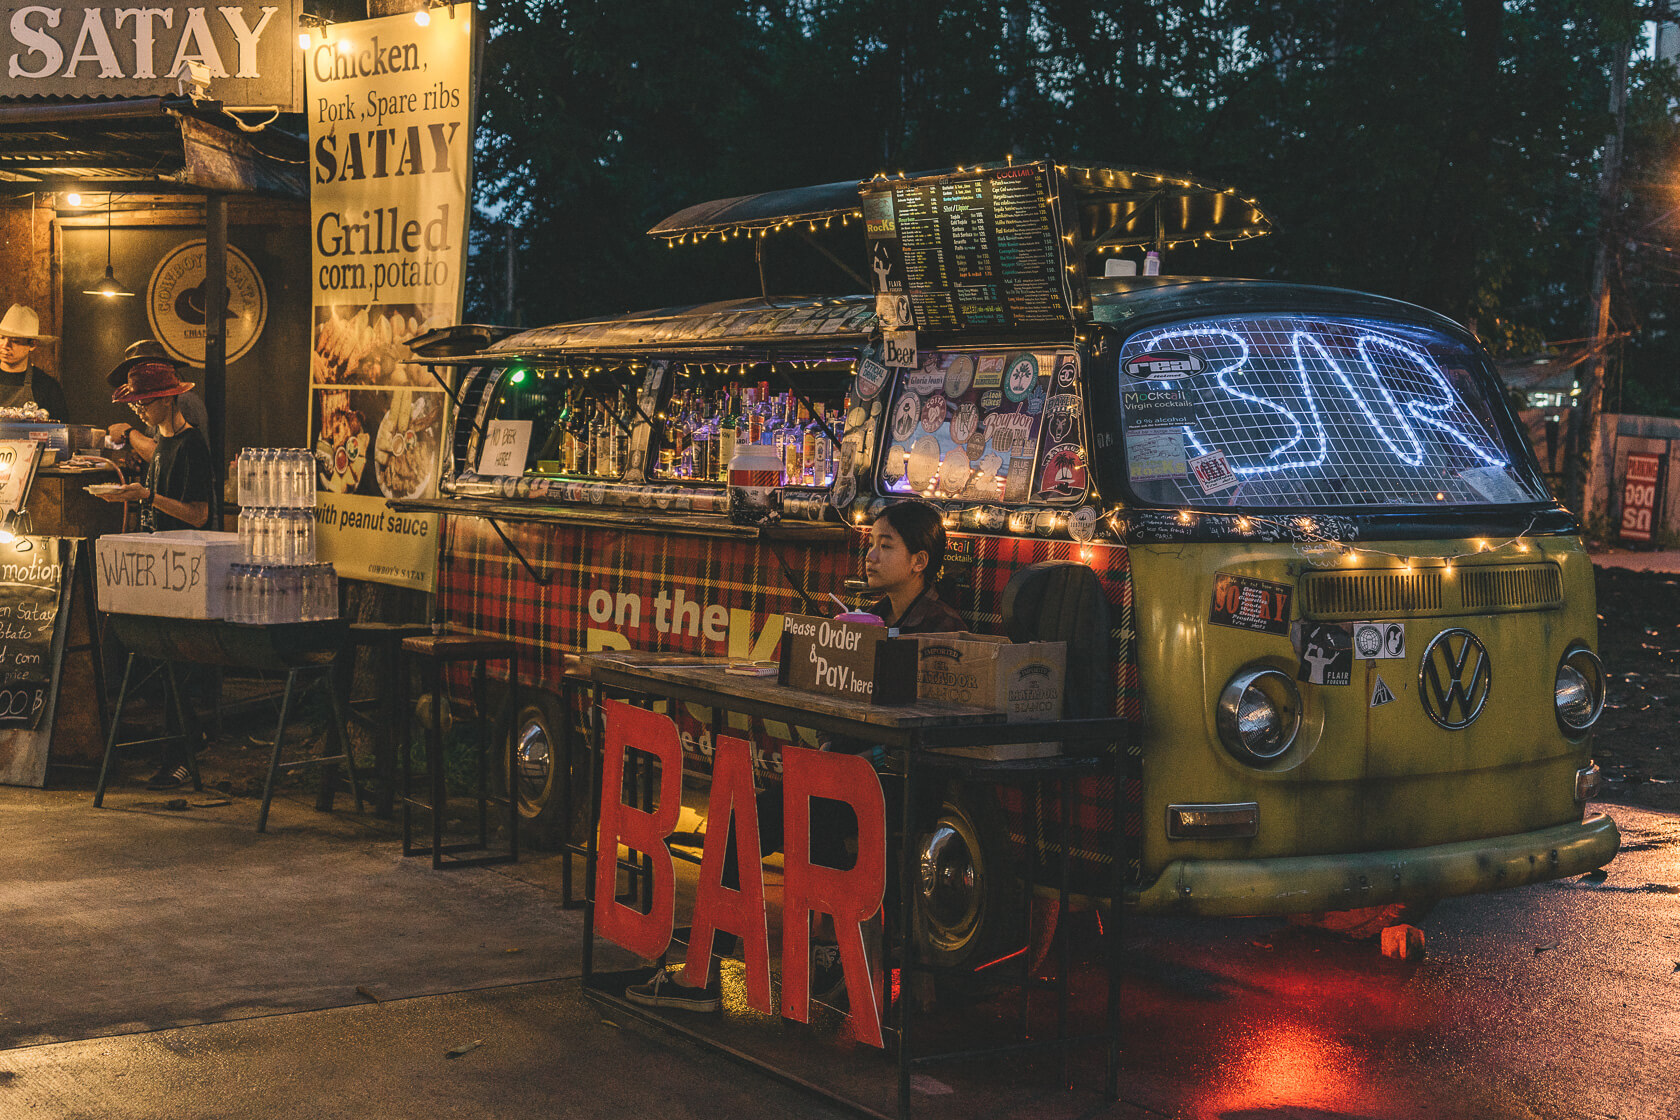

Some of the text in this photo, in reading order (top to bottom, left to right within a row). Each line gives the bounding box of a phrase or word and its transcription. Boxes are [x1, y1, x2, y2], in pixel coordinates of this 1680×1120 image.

[8, 5, 279, 80] SATAY
[313, 36, 428, 84] Chicken,
[317, 97, 356, 124] Pork
[423, 82, 460, 110] ribs
[315, 122, 460, 186] SATAY
[996, 169, 1034, 179] COCKTAILS
[316, 203, 452, 258] Grilled
[887, 340, 916, 365] Beer
[1128, 355, 1201, 374] real
[926, 395, 944, 409] COSTA
[1124, 400, 1193, 412] Virgin cocktails
[1145, 327, 1510, 477] BAR
[984, 412, 1033, 443] Bourbon
[1154, 416, 1187, 424] alcohol
[339, 510, 385, 531] peanut
[387, 514, 428, 537] sauce
[100, 549, 157, 588] WATER
[401, 569, 427, 582] SATAY
[1242, 591, 1263, 599] Wines
[1243, 585, 1263, 594] Beers
[1238, 595, 1268, 605] Cigarettes
[1240, 600, 1262, 609] Foods
[16, 601, 56, 632] Satay
[588, 588, 641, 628] on
[653, 588, 729, 643] the
[784, 616, 816, 638] Please
[818, 621, 863, 652] Order
[15, 653, 41, 665] corn
[809, 642, 818, 664] &
[4, 670, 31, 685] price
[850, 671, 874, 695] here
[917, 671, 979, 689] ATADOR
[1327, 671, 1350, 680] FLAIR
[1008, 688, 1058, 701] MATADOR
[1014, 702, 1053, 713] BLANCO
[593, 697, 885, 1048] BAR
